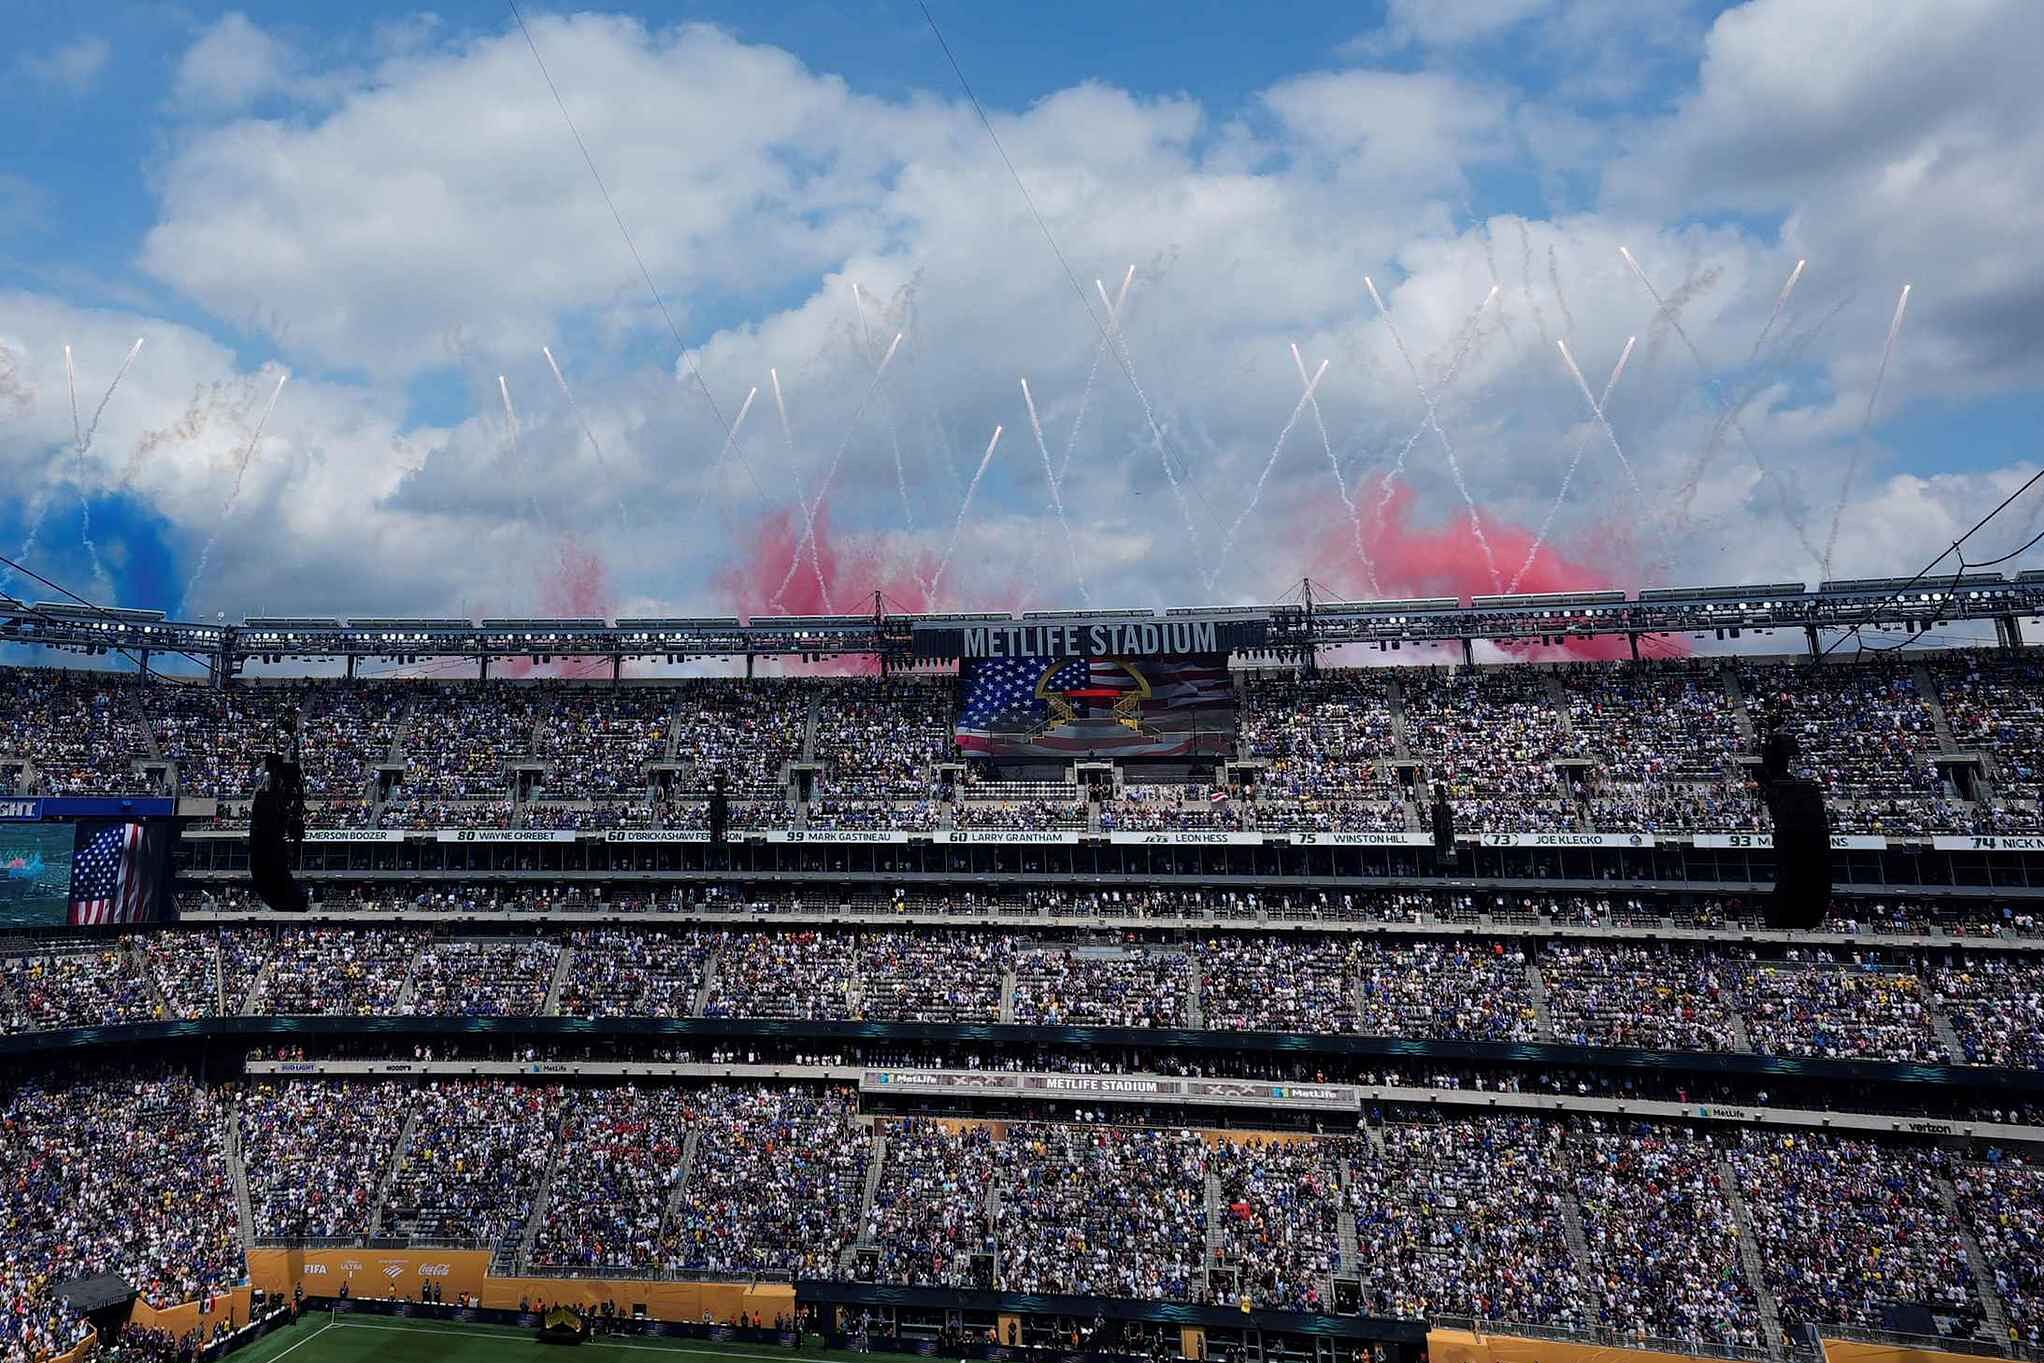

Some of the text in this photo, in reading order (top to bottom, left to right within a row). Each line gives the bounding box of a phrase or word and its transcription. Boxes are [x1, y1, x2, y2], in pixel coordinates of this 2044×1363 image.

[963, 622, 1218, 657] METLIFE STADIUM
[304, 831, 388, 840] EMERSON BOOZER
[457, 831, 555, 841] 80 WAYNE CHREBET
[607, 831, 625, 841] 60
[786, 831, 891, 841] 99 MARK GASTINEAU
[949, 832, 1063, 842] 60 LARRY GRANTHAM
[1175, 834, 1202, 842] LEON
[1203, 834, 1228, 843] HESS
[1299, 833, 1408, 843] 75 WINSTON HILL
[1492, 834, 1603, 845] 73 JOE KLECKO
[1729, 835, 1751, 847] 93
[1970, 837, 1997, 848] 74
[2002, 838, 2034, 848] NICK
[543, 1064, 567, 1072] MetLife
[896, 1074, 937, 1084] MetLife
[1046, 1078, 1157, 1092] METLIFE STADIUM
[1291, 1088, 1337, 1099] MetLife
[1713, 1109, 1745, 1119] MetLife
[1908, 1122, 1951, 1134] verizon
[304, 1263, 328, 1275] FIFA
[418, 1263, 450, 1276] Coca-Cola
